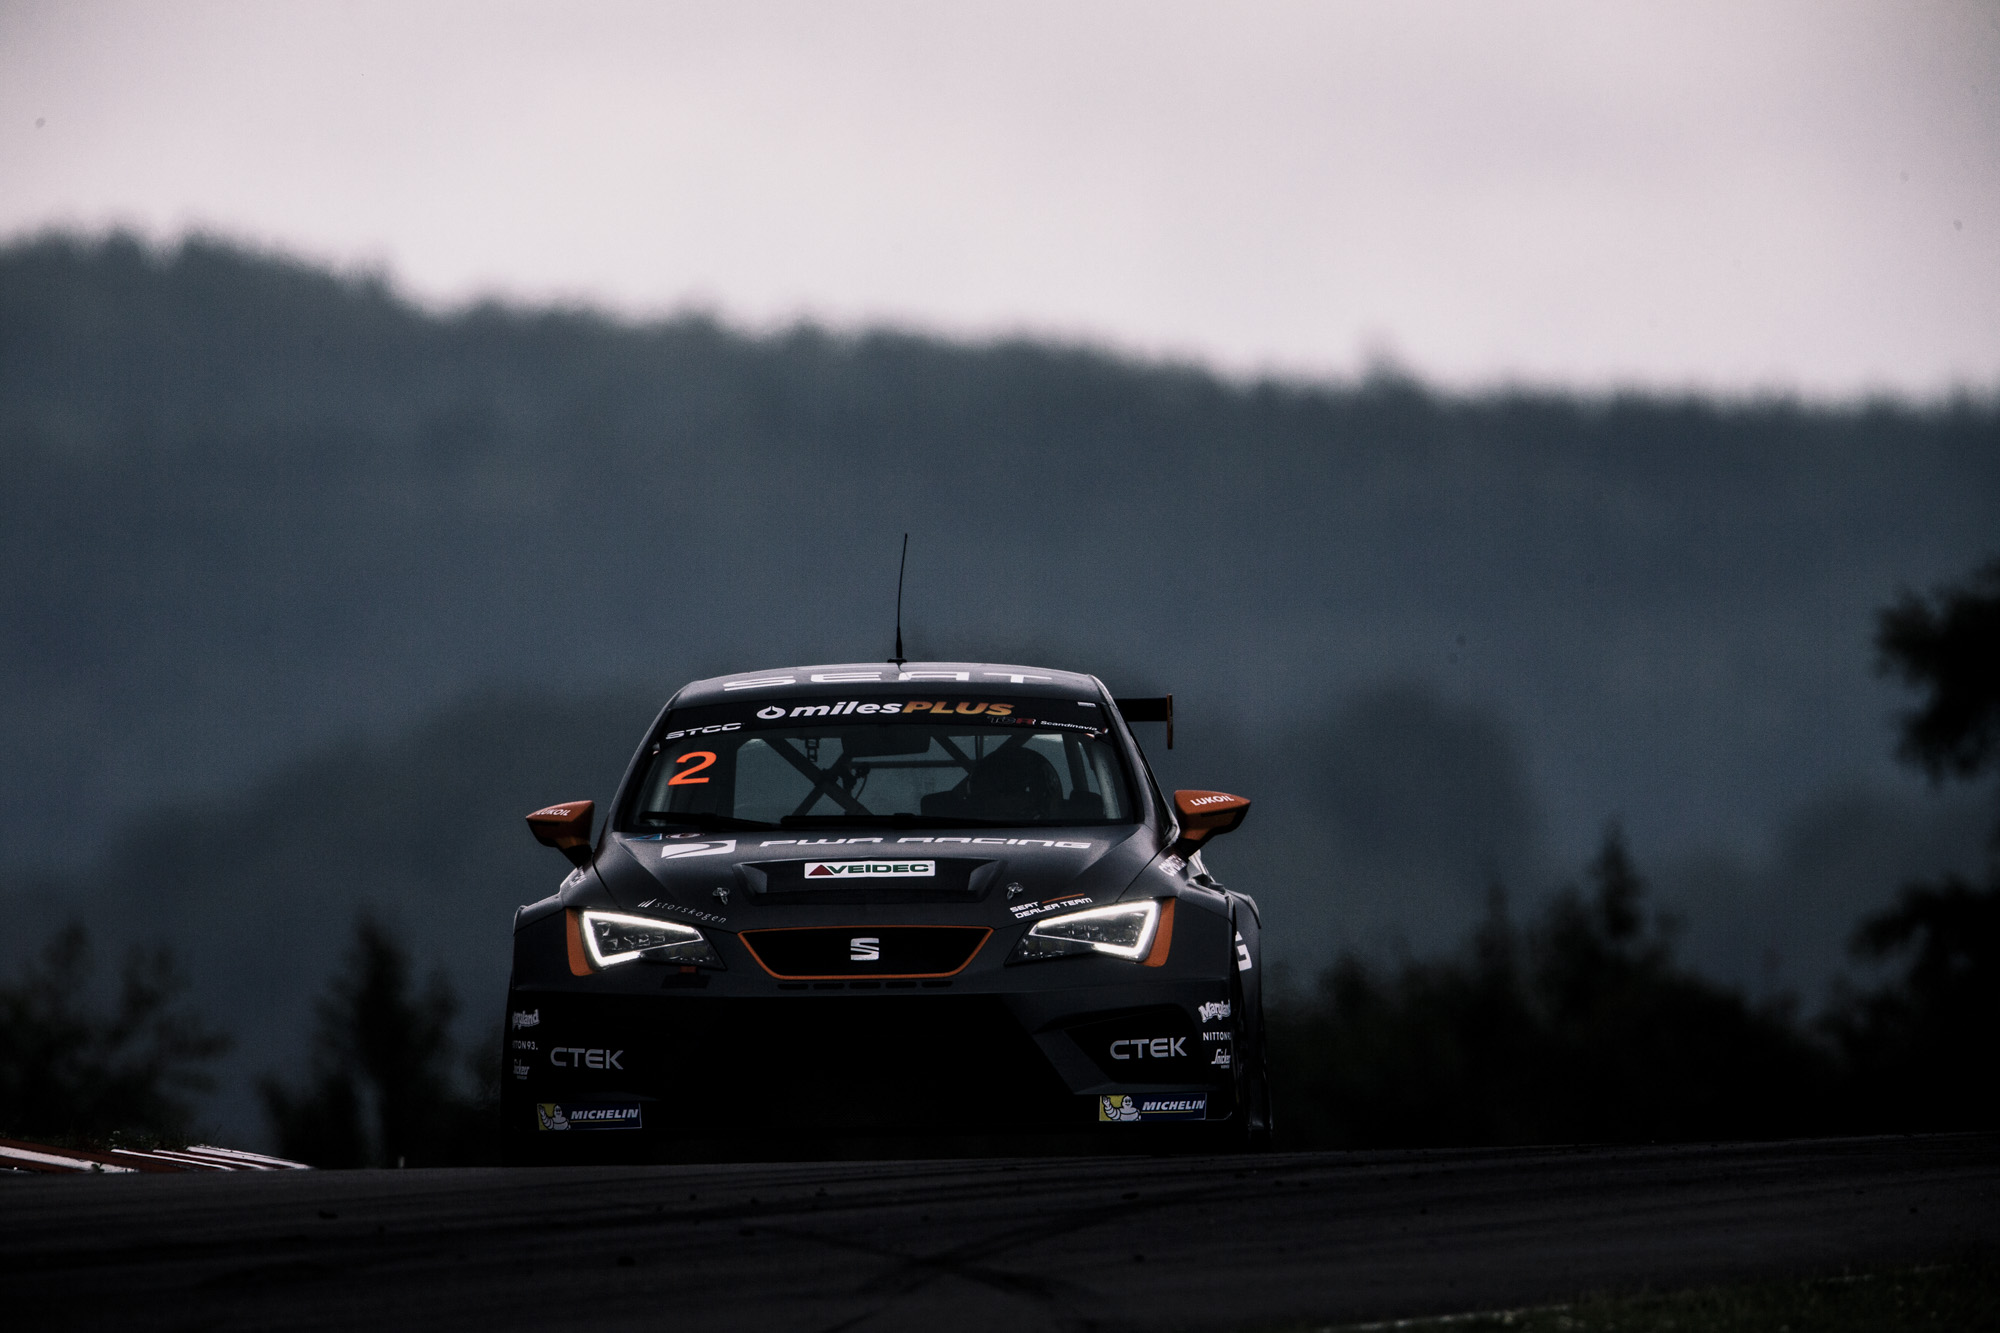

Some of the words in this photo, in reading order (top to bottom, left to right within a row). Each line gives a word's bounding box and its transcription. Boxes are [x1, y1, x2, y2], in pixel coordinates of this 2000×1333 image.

[724, 672, 1051, 691] SEAT
[665, 722, 742, 739] STCC
[1040, 720, 1098, 731] Scandinavia
[667, 750, 718, 786] 2
[1190, 795, 1235, 806] LUKOIL
[760, 837, 884, 848] PWR
[826, 863, 929, 874] VEIDEC
[655, 902, 727, 924] storskogen
[1010, 901, 1039, 913] SEAT
[1014, 903, 1061, 919] DEALER
[1060, 897, 1093, 907] TEAM
[1110, 1036, 1188, 1060] CTEK
[550, 1046, 624, 1071] CTEK
[1142, 1099, 1206, 1111] MICHELIN
[570, 1108, 639, 1121] MICHELIN
